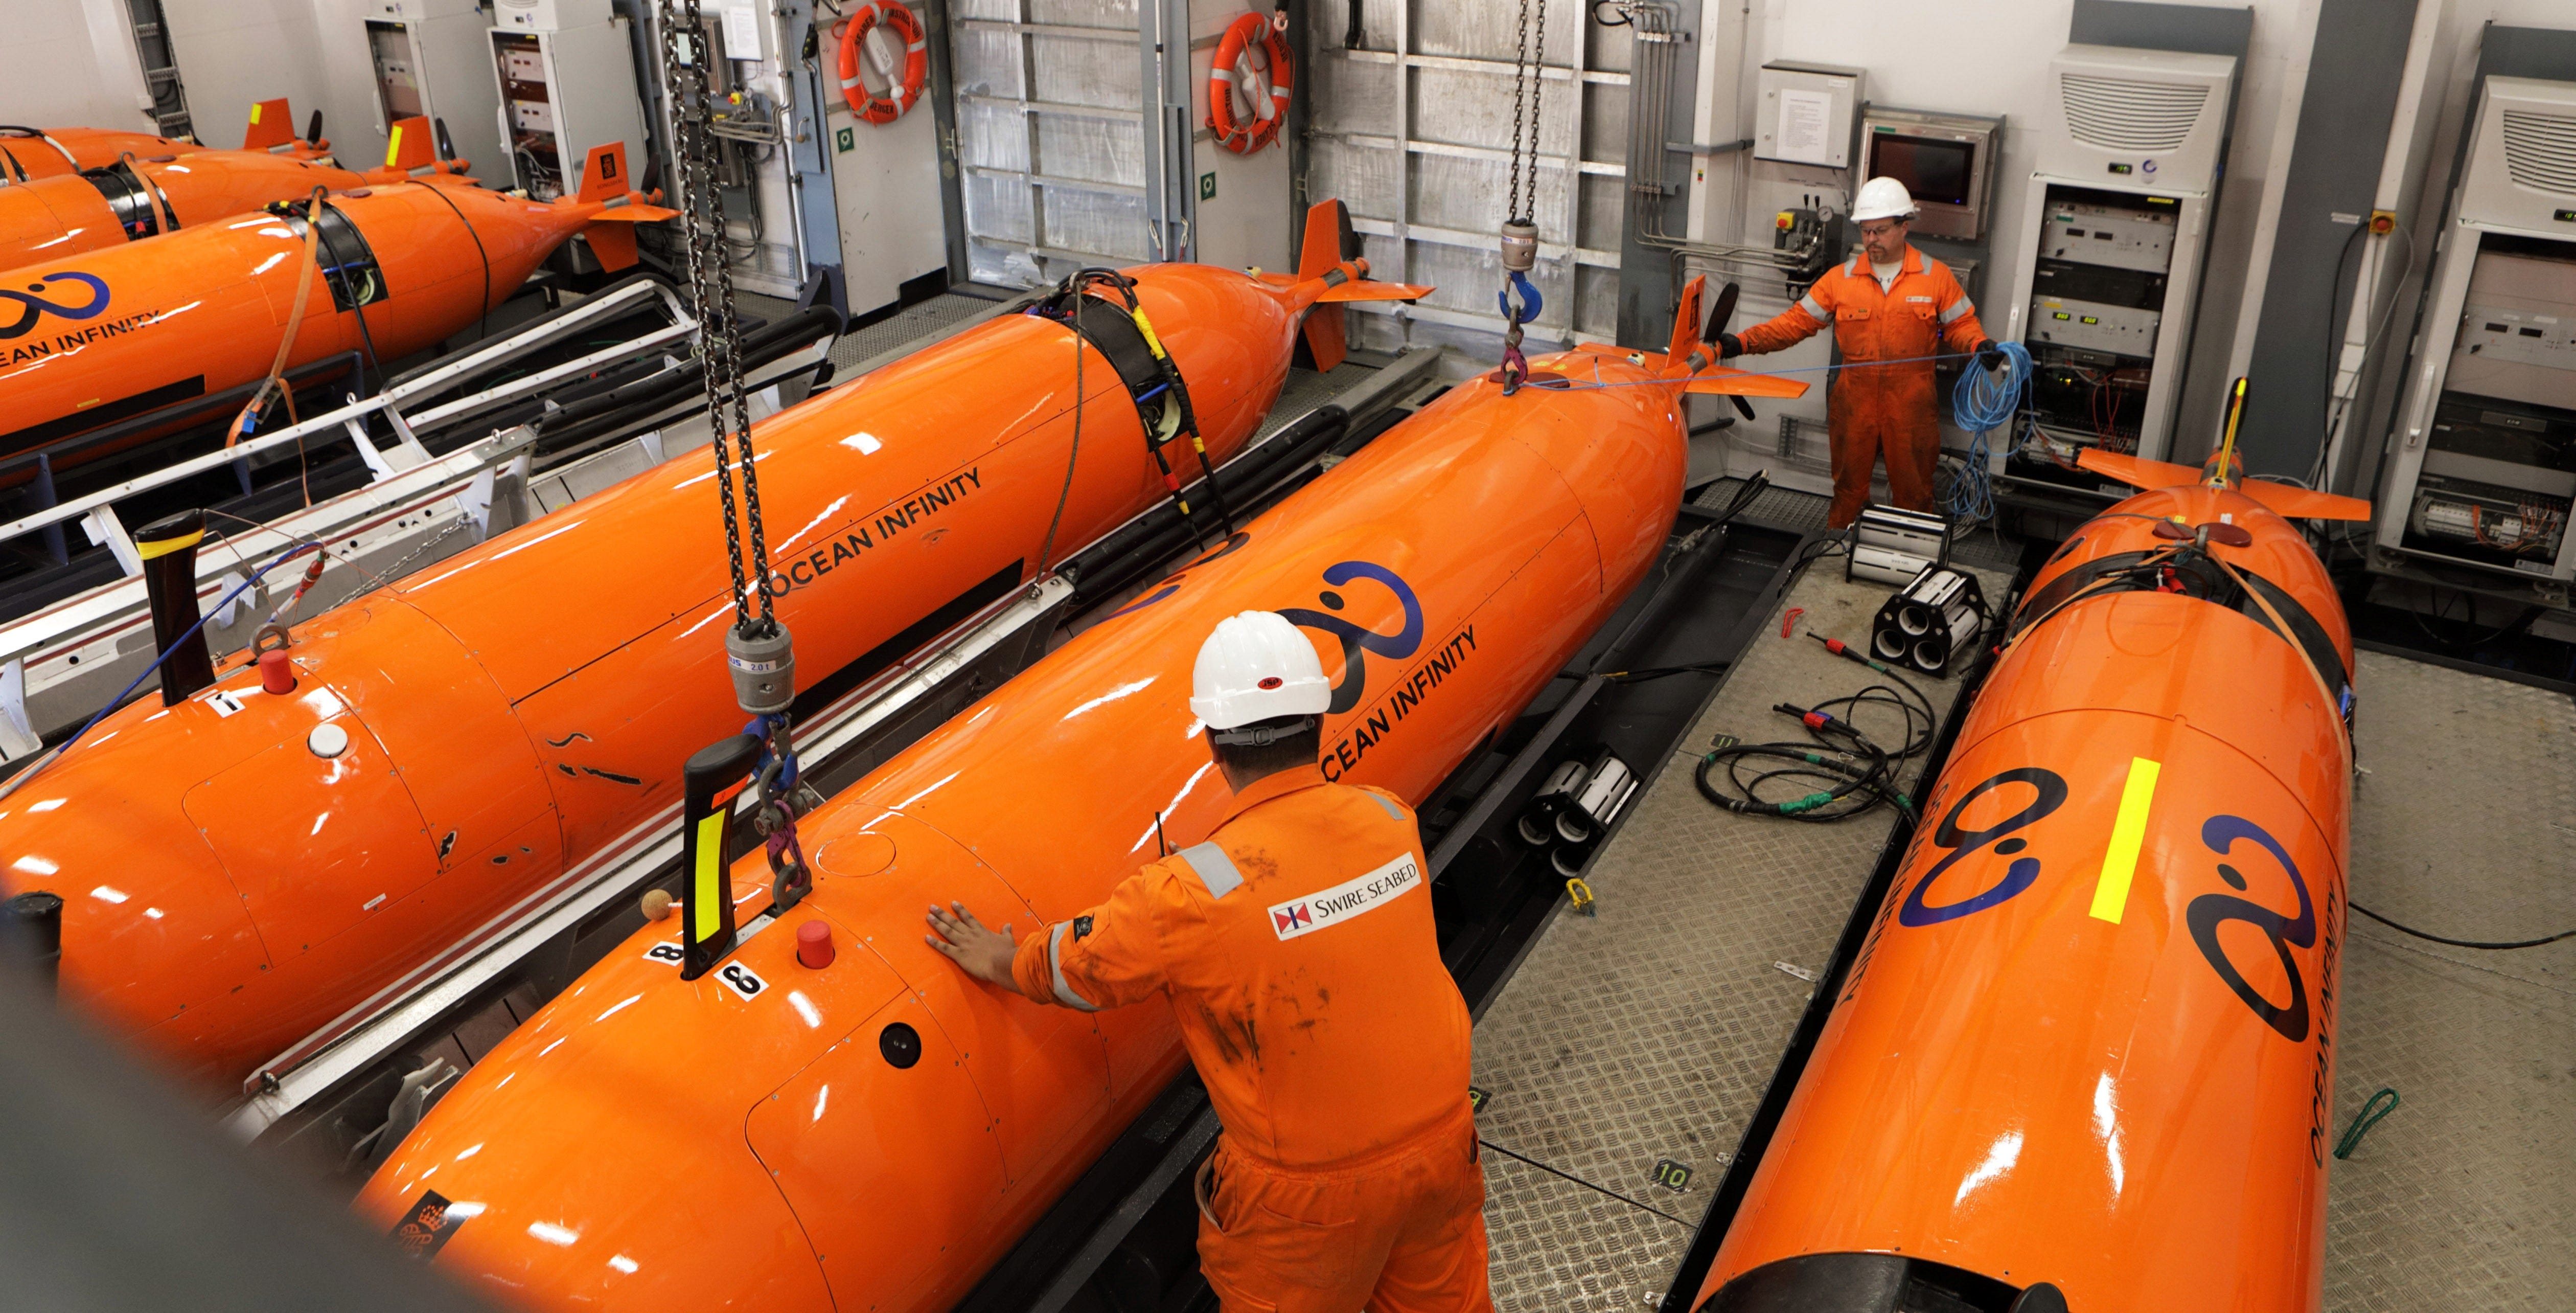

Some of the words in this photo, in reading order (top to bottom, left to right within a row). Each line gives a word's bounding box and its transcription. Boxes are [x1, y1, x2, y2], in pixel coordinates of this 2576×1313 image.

[56, 310, 159, 350] INFINITY
[769, 528, 873, 598] OCEAN
[876, 467, 981, 540] INFINITY
[215, 693, 238, 711] 1
[1262, 678, 1279, 687] JSP
[1321, 708, 1390, 783] CEAN
[1390, 624, 1476, 721] INFINITY
[1315, 888, 1367, 918] SWIRE
[1367, 863, 1416, 900] SEABED
[650, 945, 684, 961] 8
[2320, 879, 2338, 1027] INFINITY
[723, 966, 761, 994] 8
[2311, 1016, 2330, 1169] OCEAN
[1659, 1164, 1686, 1187] 10
